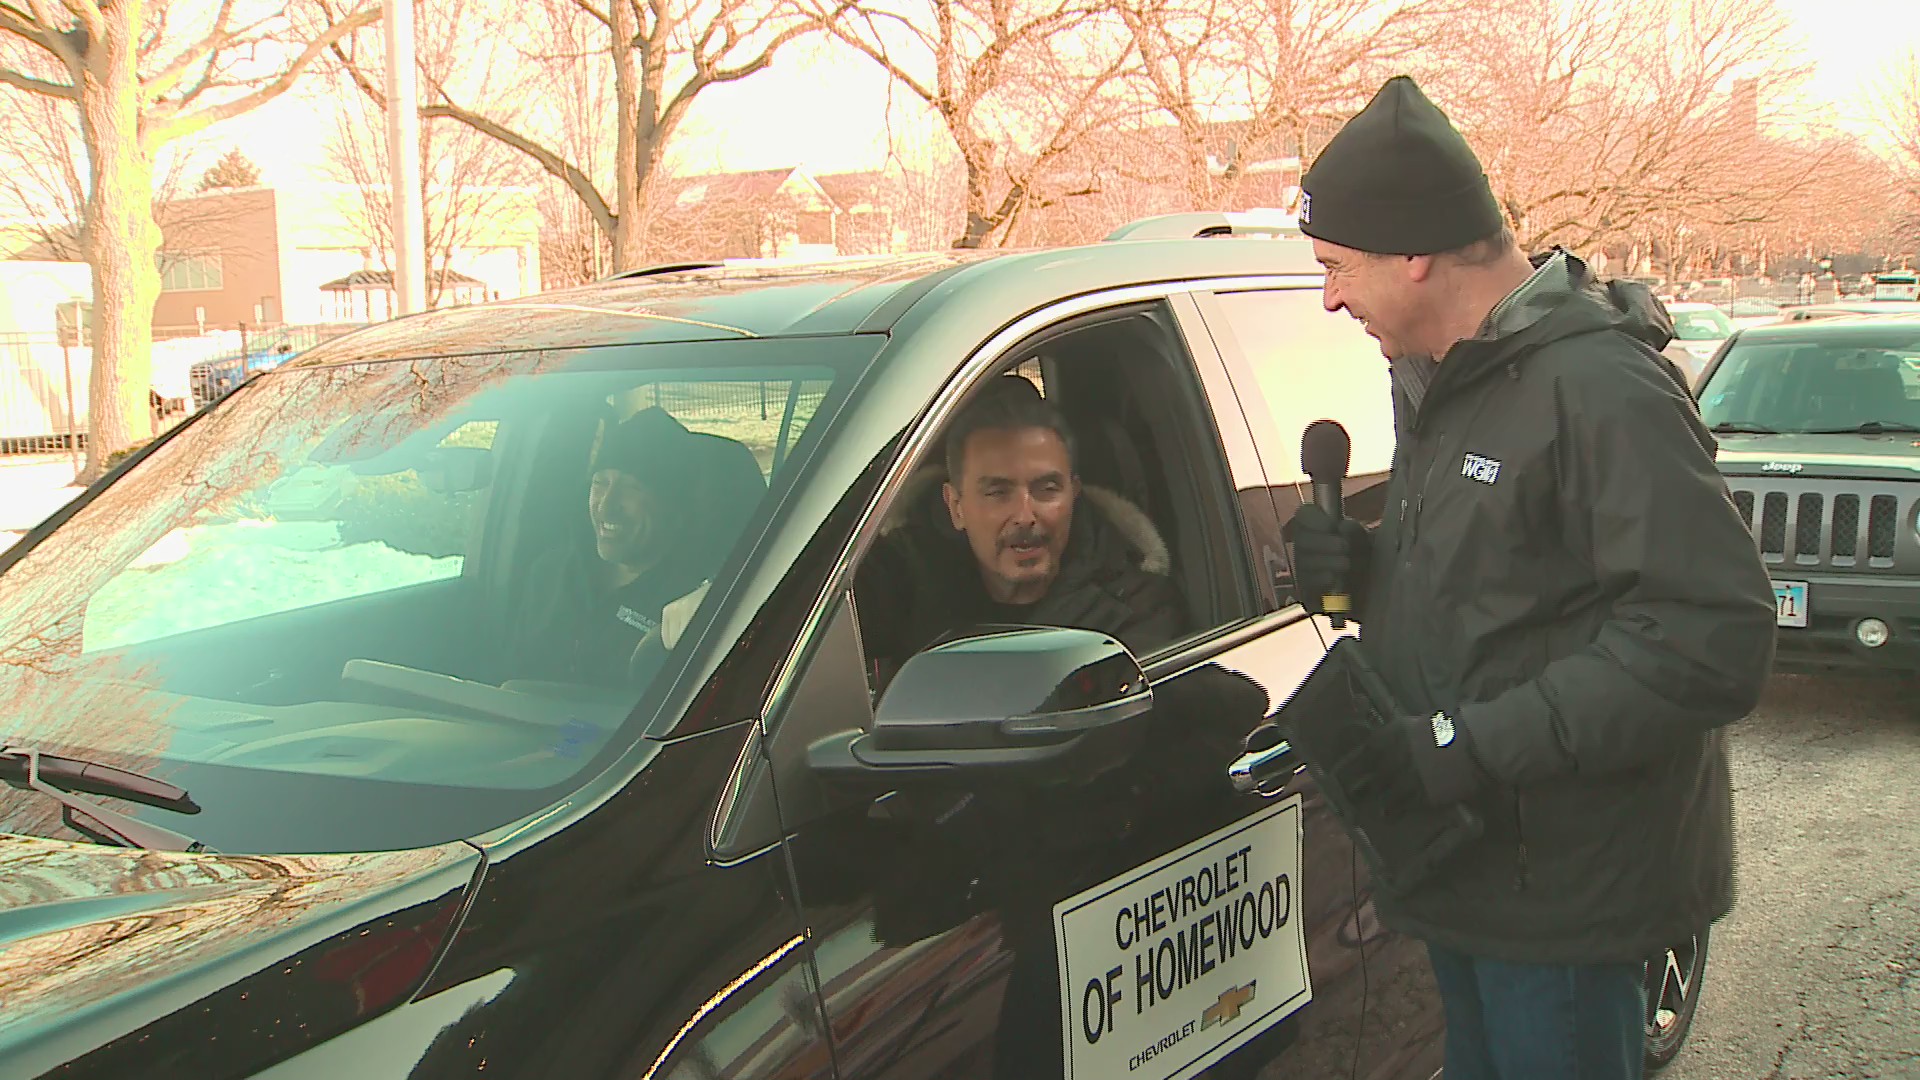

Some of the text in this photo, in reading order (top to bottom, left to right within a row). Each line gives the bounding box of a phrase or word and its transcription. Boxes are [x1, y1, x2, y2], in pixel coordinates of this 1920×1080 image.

[1761, 462, 1804, 474] Jeep
[1115, 845, 1252, 950] CHEVROLET
[1083, 873, 1291, 1044] OF HOMEWOOD
[1129, 1019, 1196, 1072] CHEVROLET
